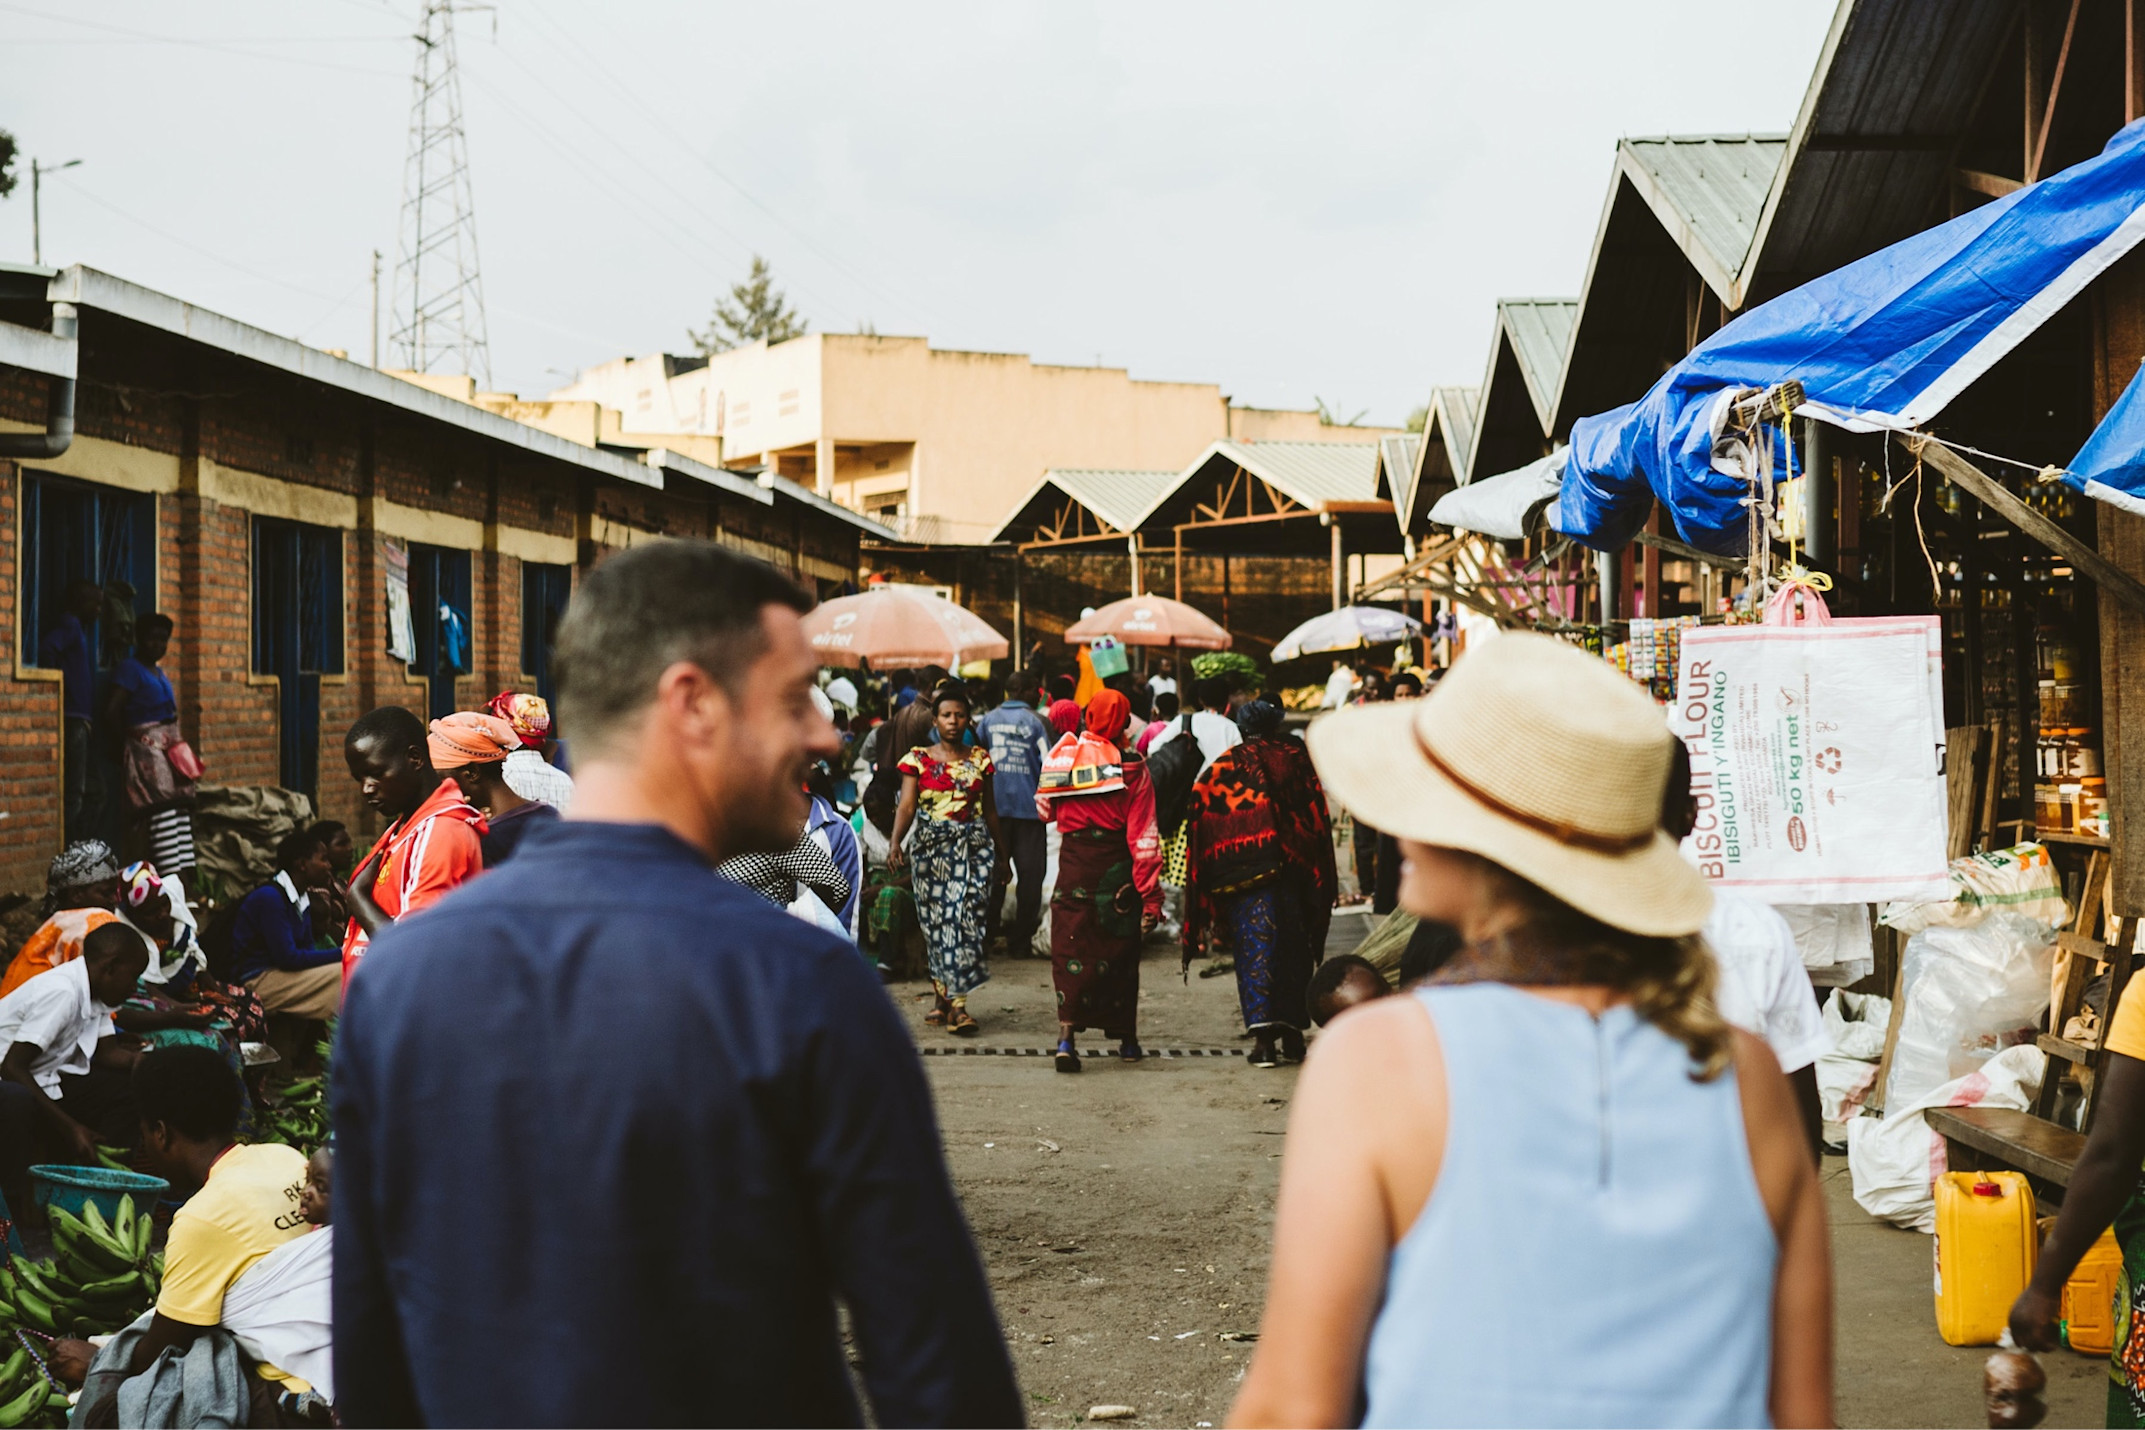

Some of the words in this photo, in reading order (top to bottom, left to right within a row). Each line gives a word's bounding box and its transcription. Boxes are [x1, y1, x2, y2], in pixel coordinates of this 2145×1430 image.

[812, 632, 852, 647] airtel
[1685, 660, 1712, 756] FLOUR
[1712, 671, 1728, 766] Y'INGANO
[1786, 714, 1799, 748] net
[1788, 755, 1803, 780] kg
[1690, 772, 1724, 878] BISCUIT
[1718, 773, 1740, 863] IBISIGUTI
[1790, 787, 1803, 815] 50
